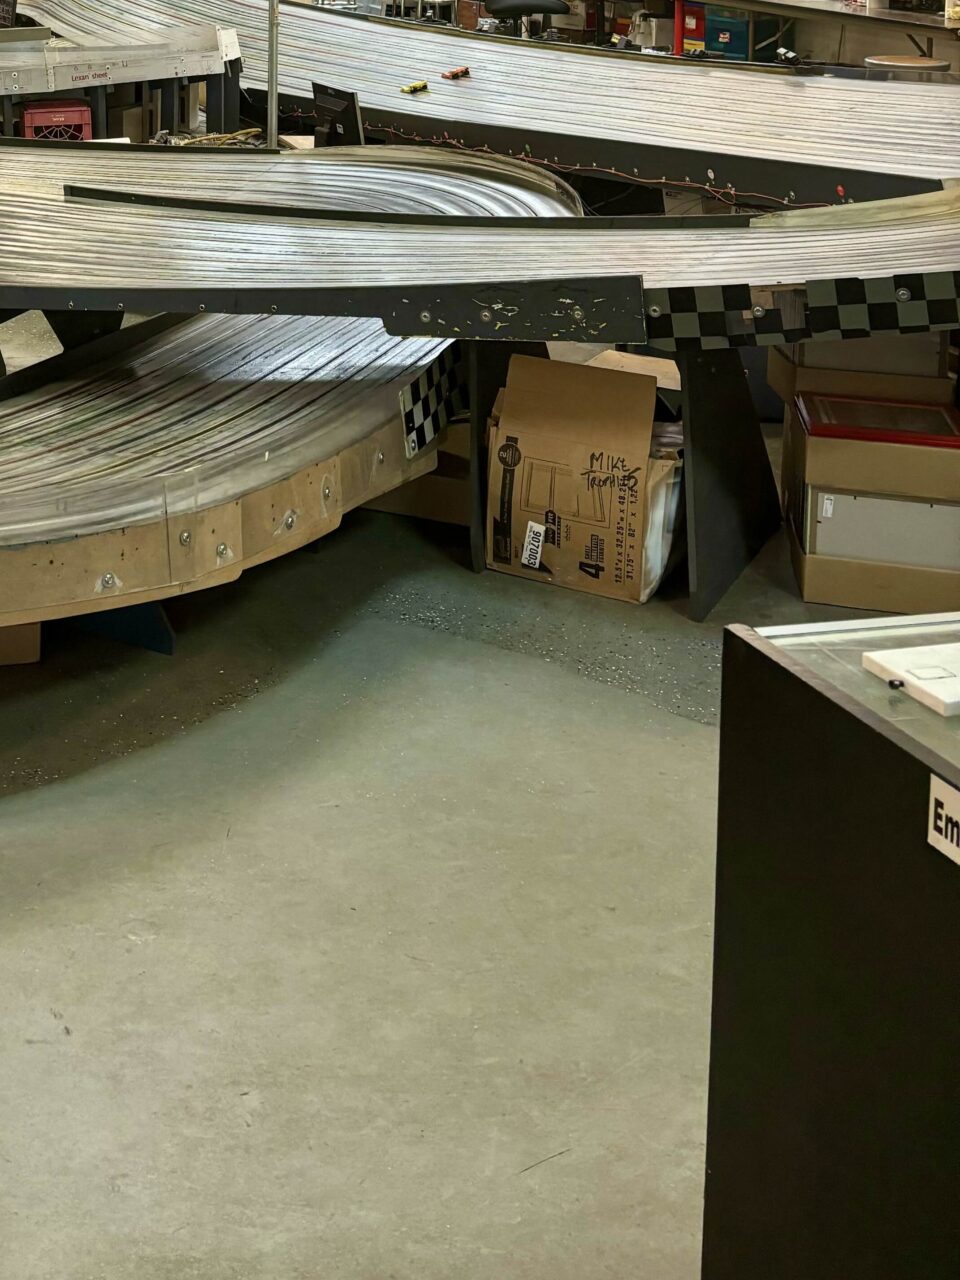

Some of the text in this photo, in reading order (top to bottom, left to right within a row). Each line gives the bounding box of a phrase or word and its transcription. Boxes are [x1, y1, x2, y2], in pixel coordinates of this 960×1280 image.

[91, 71, 108, 80] sheet
[589, 452, 631, 473] MIKE
[527, 530, 542, 569] 907003
[579, 561, 605, 580] 4
